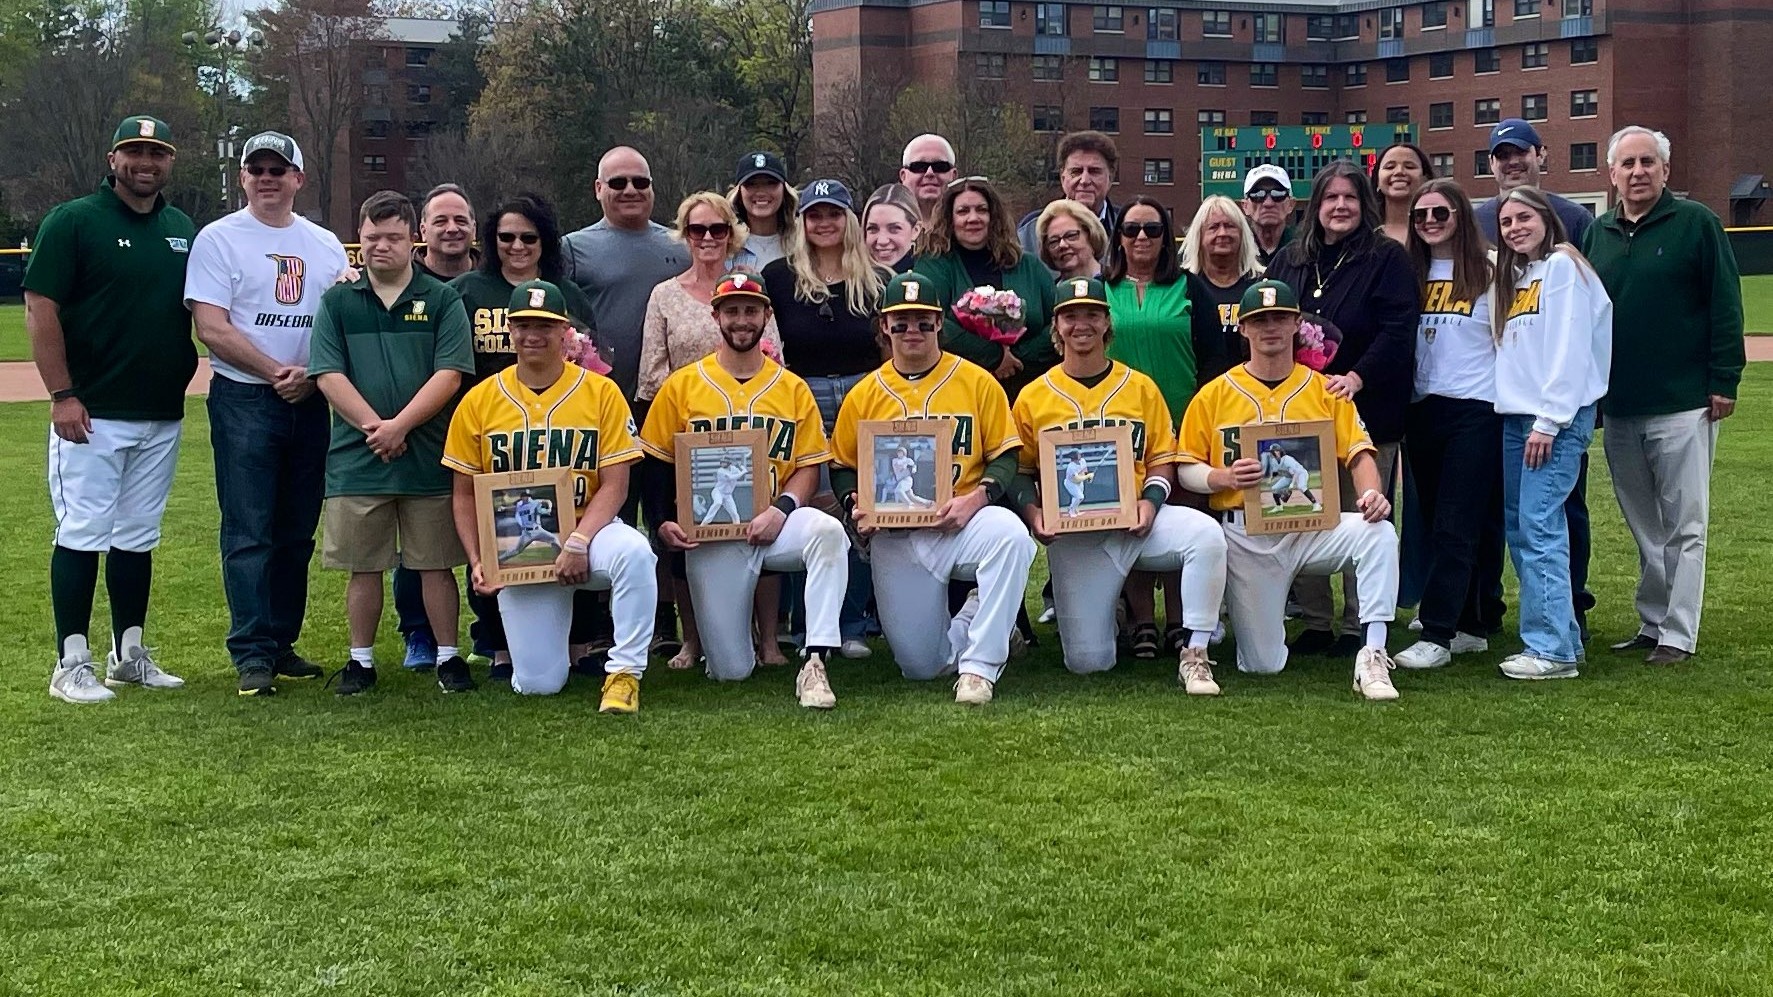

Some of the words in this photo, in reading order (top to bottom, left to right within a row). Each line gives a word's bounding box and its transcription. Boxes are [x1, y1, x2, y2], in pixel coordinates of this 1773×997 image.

[1305, 126, 1331, 136] STRIKE
[1349, 125, 1365, 134] OUT
[1209, 157, 1236, 168] GUEST
[814, 182, 829, 196] NY
[488, 428, 599, 475] SIENA
[876, 515, 911, 525] SENIOR
[917, 515, 934, 524] DAY
[1061, 518, 1095, 529] SENIOR
[1101, 517, 1117, 526] DAY
[1264, 520, 1299, 531] SENIOR
[1305, 519, 1322, 528] DAY
[735, 527, 747, 537] DA
[500, 570, 536, 583] SENIOR
[542, 569, 554, 580] DA
